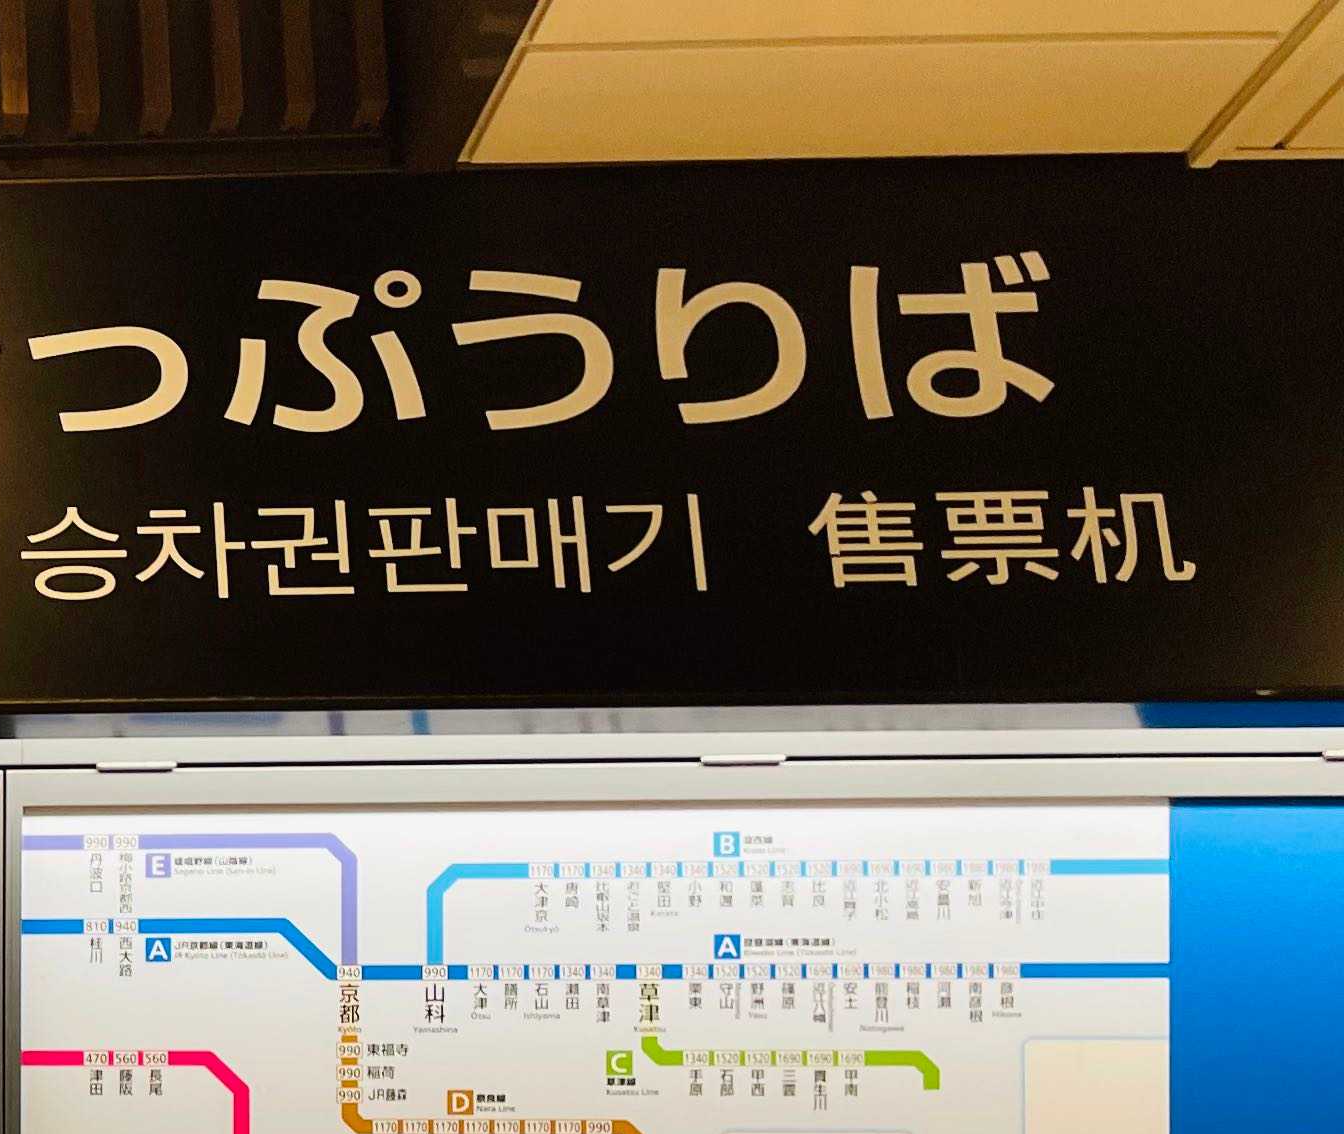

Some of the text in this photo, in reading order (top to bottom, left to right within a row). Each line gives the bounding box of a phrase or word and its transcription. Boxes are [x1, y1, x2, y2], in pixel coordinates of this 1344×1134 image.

[19, 494, 708, 600] 승차권판매기
[807, 484, 1198, 588] 售票机
[339, 983, 360, 1024] 京都
[424, 984, 445, 1024] 山科
[639, 983, 660, 1023] 草津
[367, 1042, 408, 1057] 東福寺
